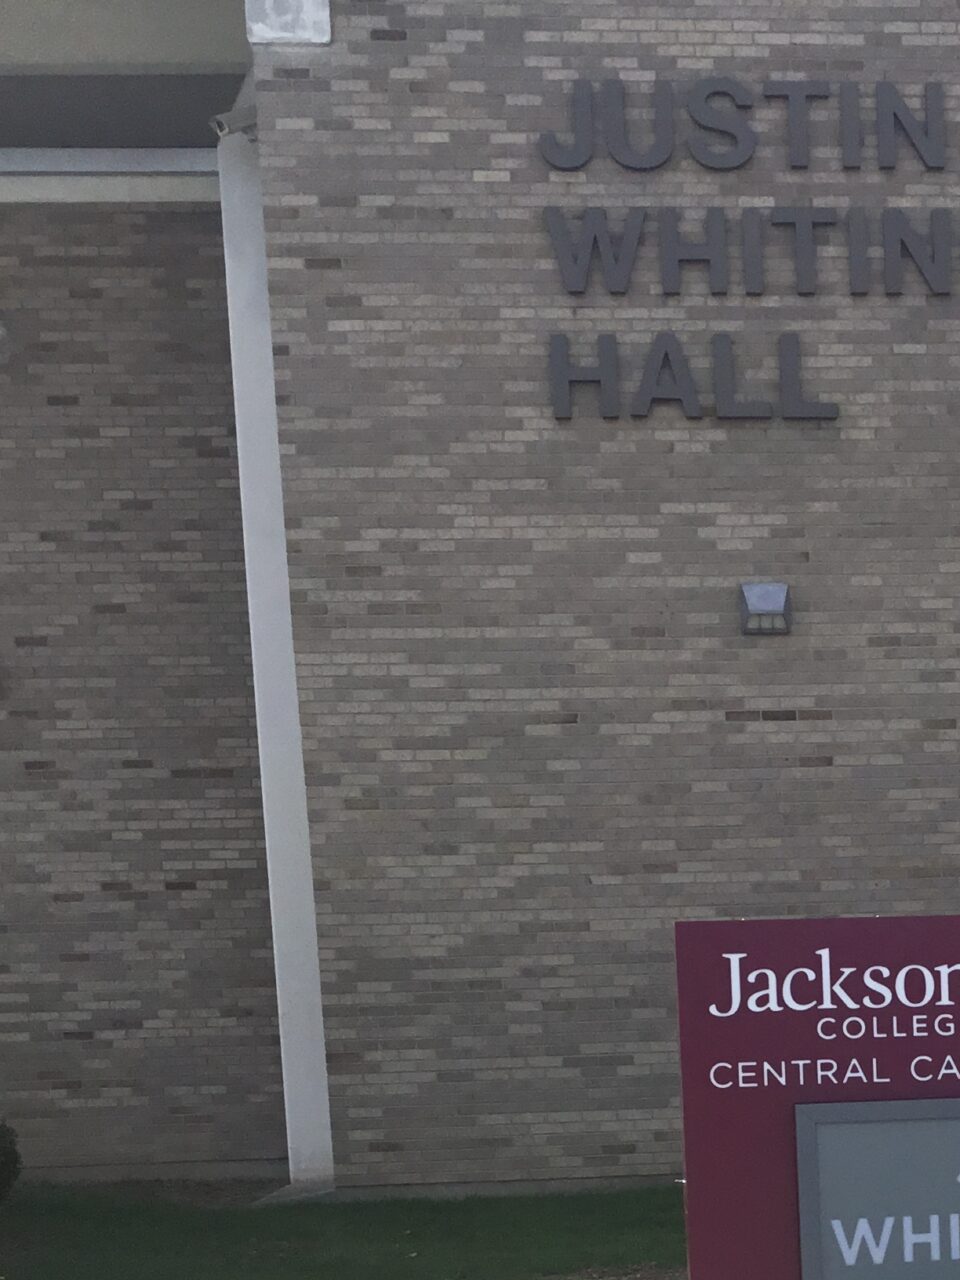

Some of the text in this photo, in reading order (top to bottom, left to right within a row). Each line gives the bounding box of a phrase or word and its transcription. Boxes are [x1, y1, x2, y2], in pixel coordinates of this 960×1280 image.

[537, 77, 945, 171] JUSTIN
[549, 330, 839, 420] HALL
[709, 1058, 891, 1089] CENTRAL
